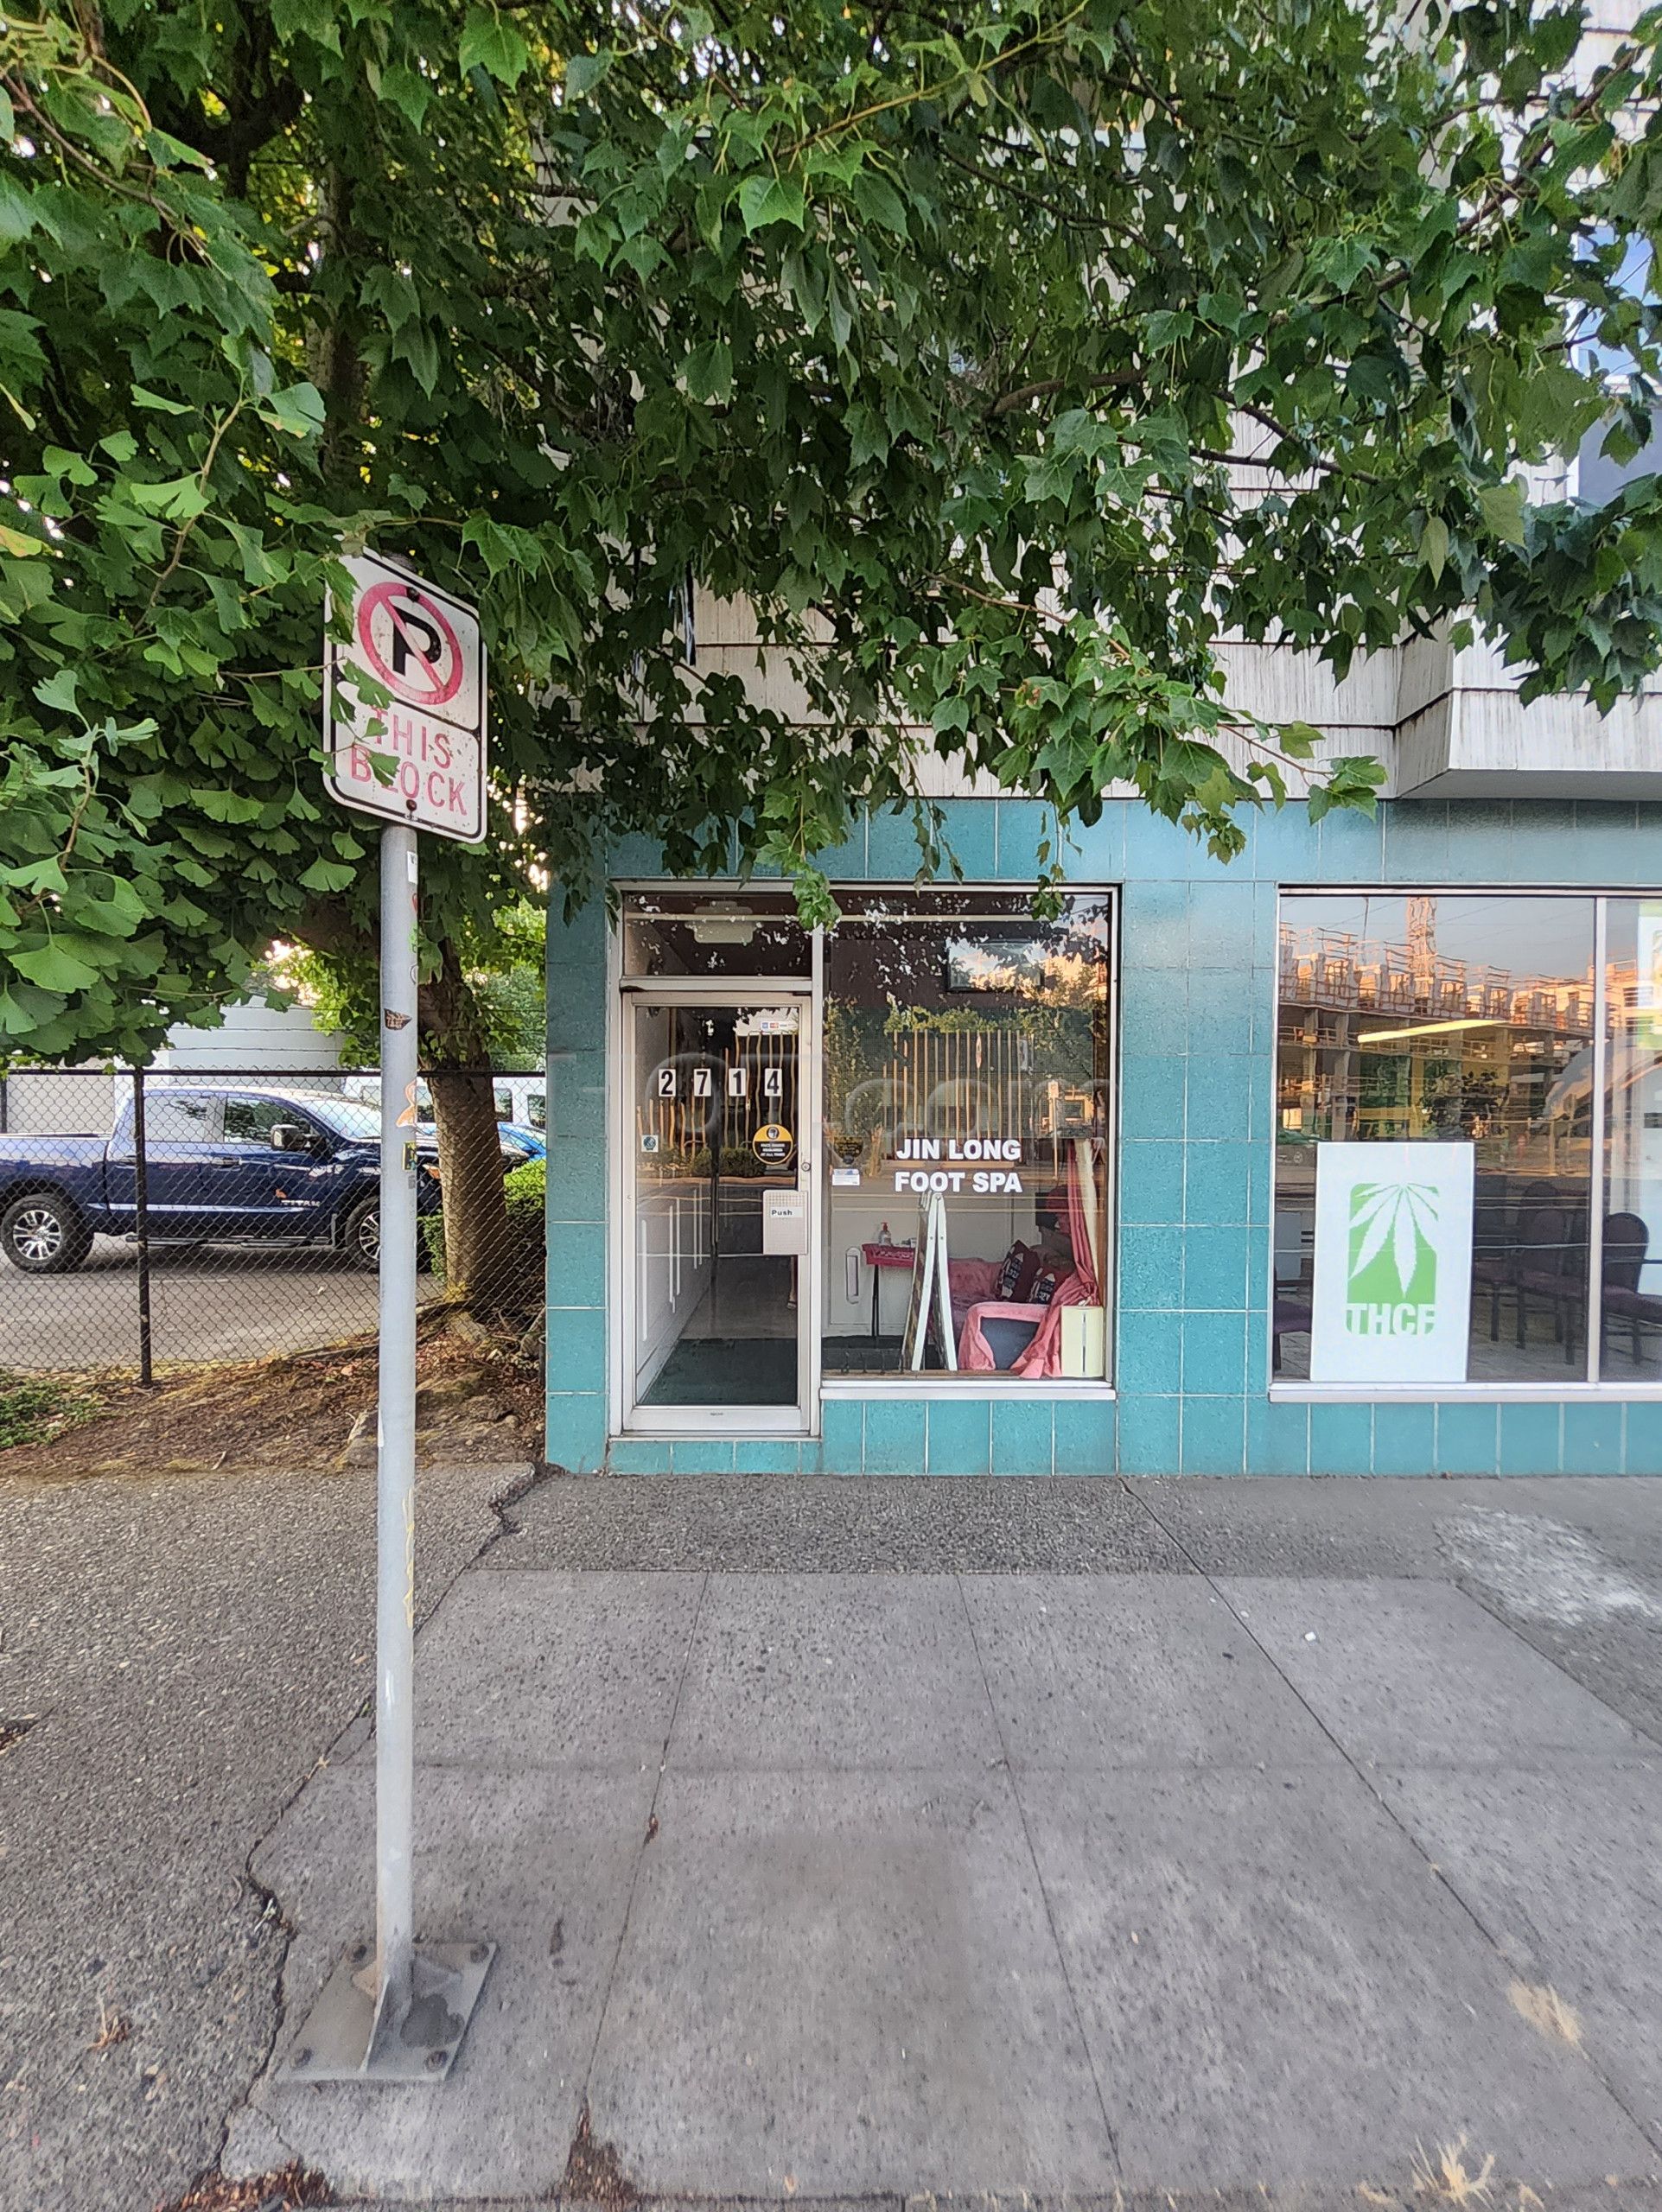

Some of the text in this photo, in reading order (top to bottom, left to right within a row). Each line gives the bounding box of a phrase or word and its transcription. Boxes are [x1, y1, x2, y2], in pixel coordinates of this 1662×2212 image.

[660, 1071, 780, 1096] 2714
[896, 1139, 1022, 1161] JIN LONG
[895, 1172, 1022, 1193] FOOT SPA
